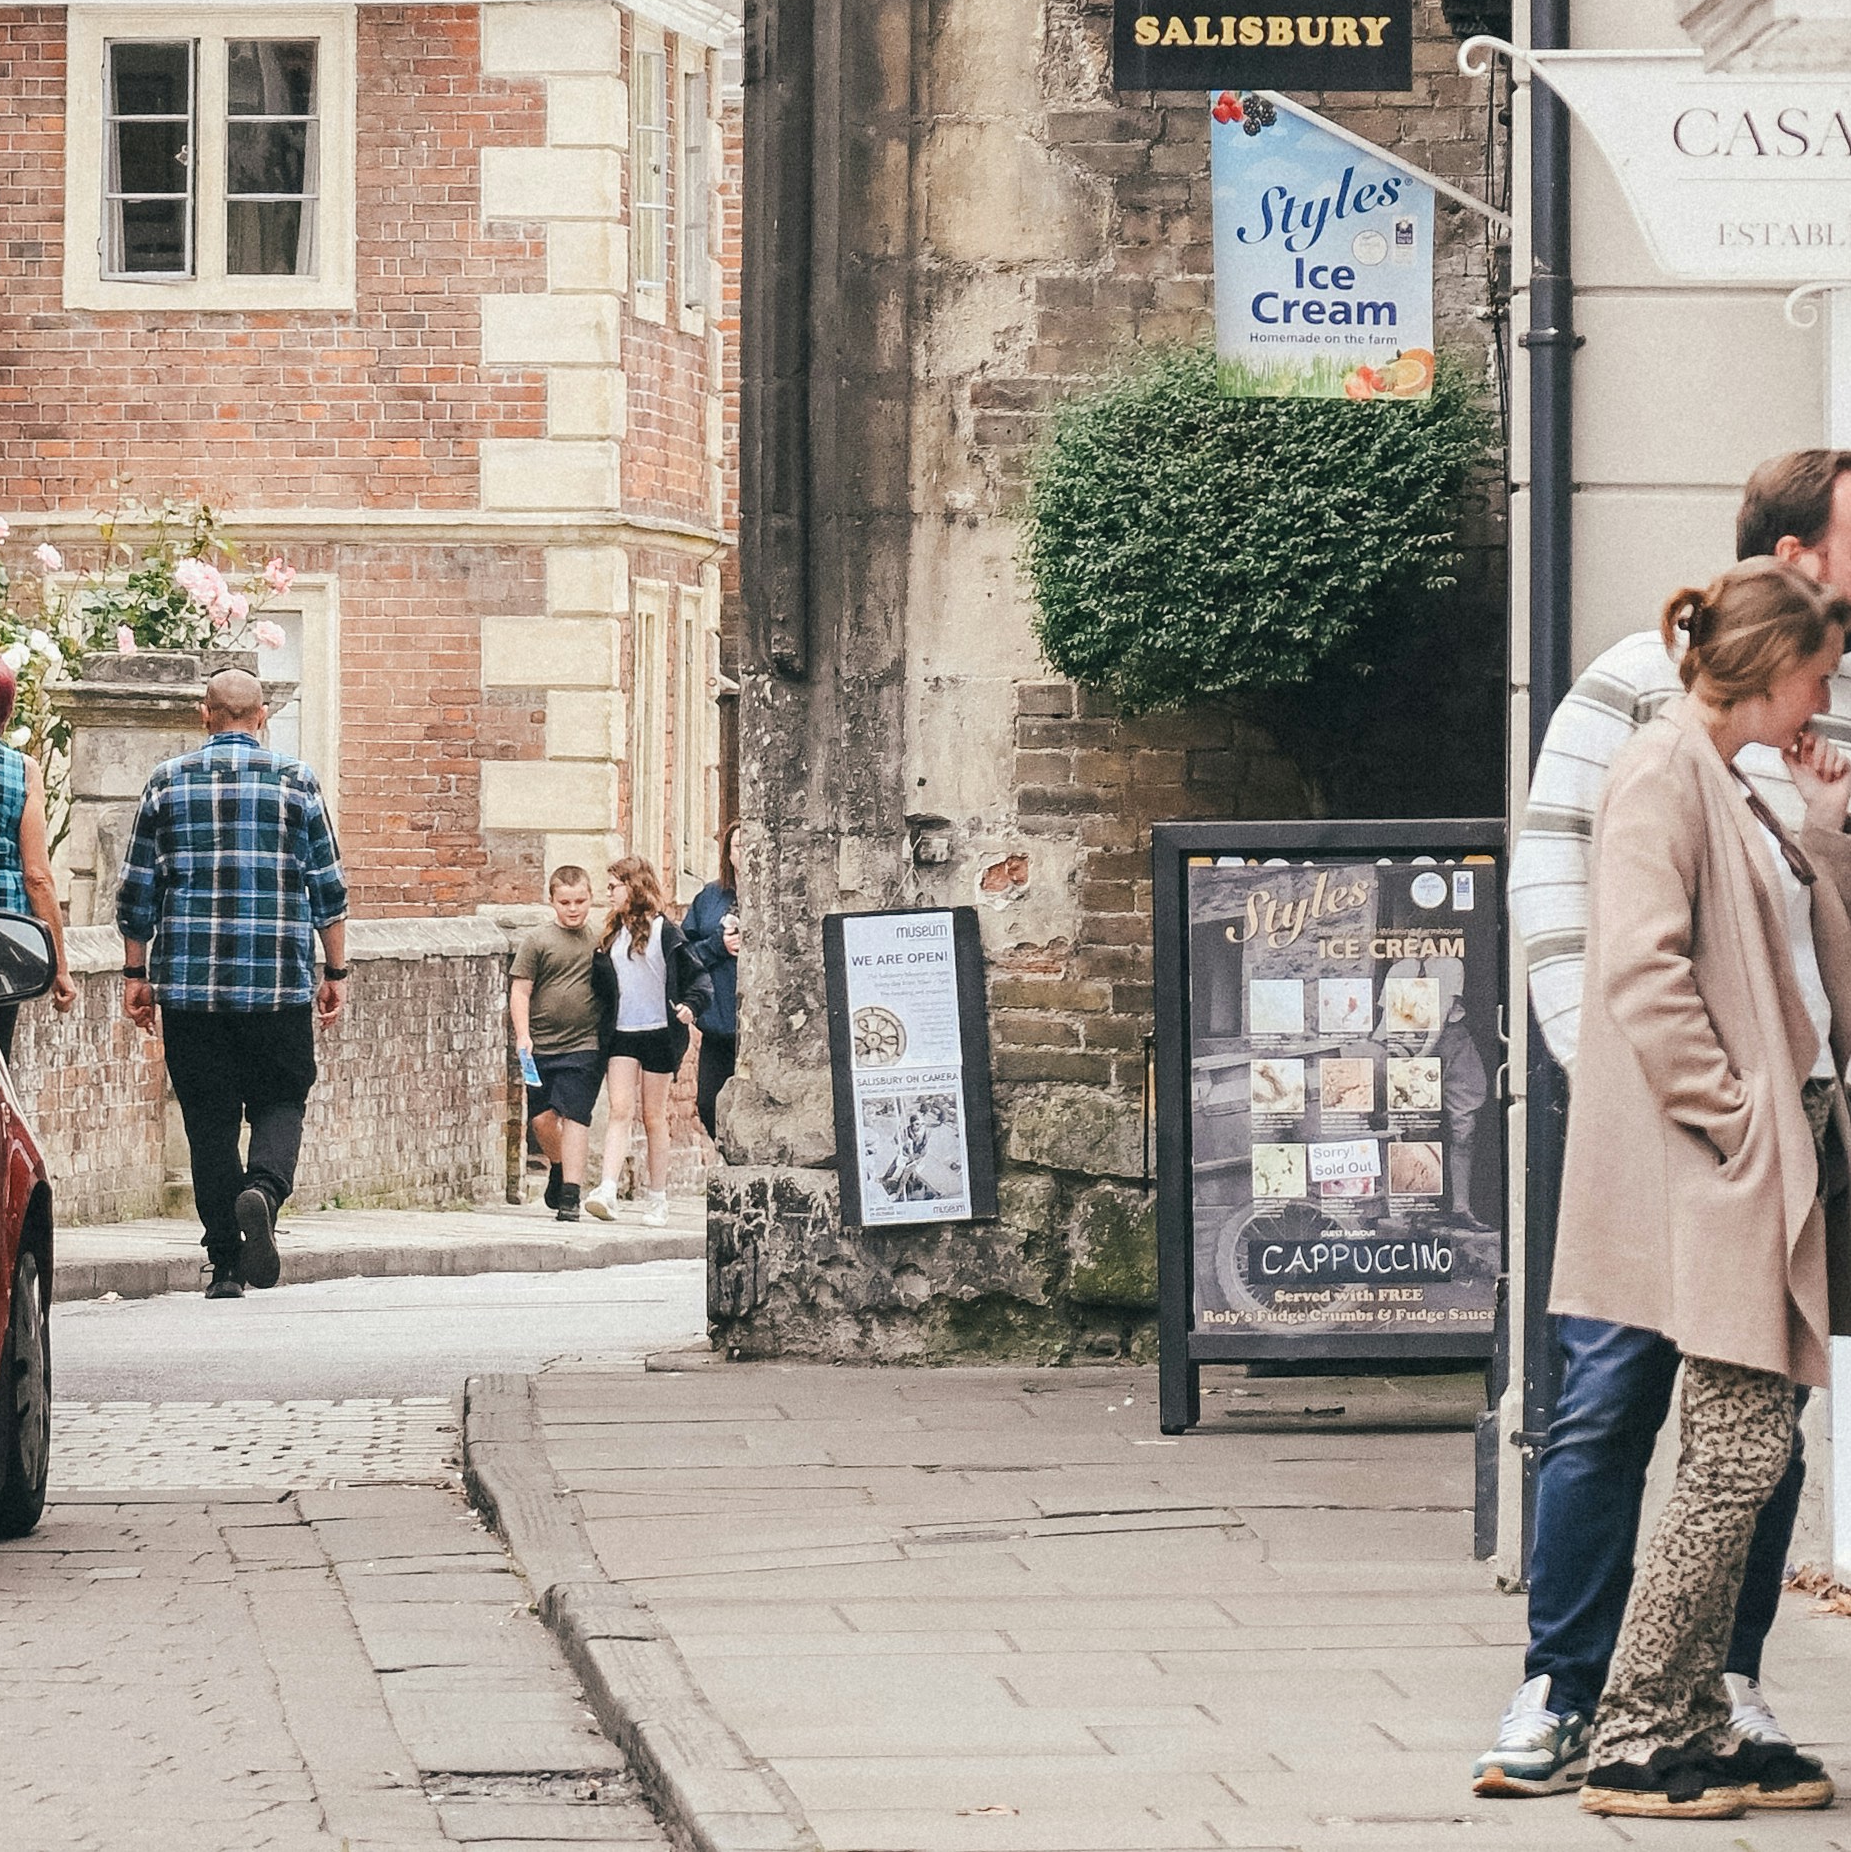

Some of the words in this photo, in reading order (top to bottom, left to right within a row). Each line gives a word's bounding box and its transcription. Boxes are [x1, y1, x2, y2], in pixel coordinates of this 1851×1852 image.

[1134, 16, 1391, 46] SALISBURY
[1237, 165, 1401, 252] Styles
[1295, 257, 1356, 290] Ice
[1251, 291, 1397, 326] Cream
[1249, 333, 1321, 344] Homemade
[1324, 335, 1341, 344] on
[1344, 333, 1365, 344] the
[1369, 333, 1398, 345] farm
[1225, 871, 1369, 948] Styles
[896, 924, 948, 938] museum
[1319, 939, 1360, 959] ICE
[1368, 937, 1465, 959] CREAM
[851, 956, 872, 966] WE
[876, 954, 904, 965] ARE
[856, 1076, 903, 1087] SALISBURY
[905, 1074, 920, 1084] ON
[922, 1072, 959, 1082] CAMERA
[1313, 1145, 1355, 1160] Sorry!
[1315, 1162, 1345, 1177] Sold
[1347, 1161, 1374, 1174] Out
[1262, 1238, 1453, 1275] CAPPUCCINO
[1274, 1289, 1330, 1302] Served
[1333, 1288, 1375, 1302] with
[1377, 1288, 1424, 1302] FREE
[1203, 1309, 1252, 1324] Roly's
[1256, 1309, 1306, 1324] Fudge
[1309, 1309, 1374, 1322] Crumbs
[1377, 1309, 1393, 1322] &
[1395, 1308, 1445, 1323] Fudge
[1448, 1308, 1495, 1321] Sauce
